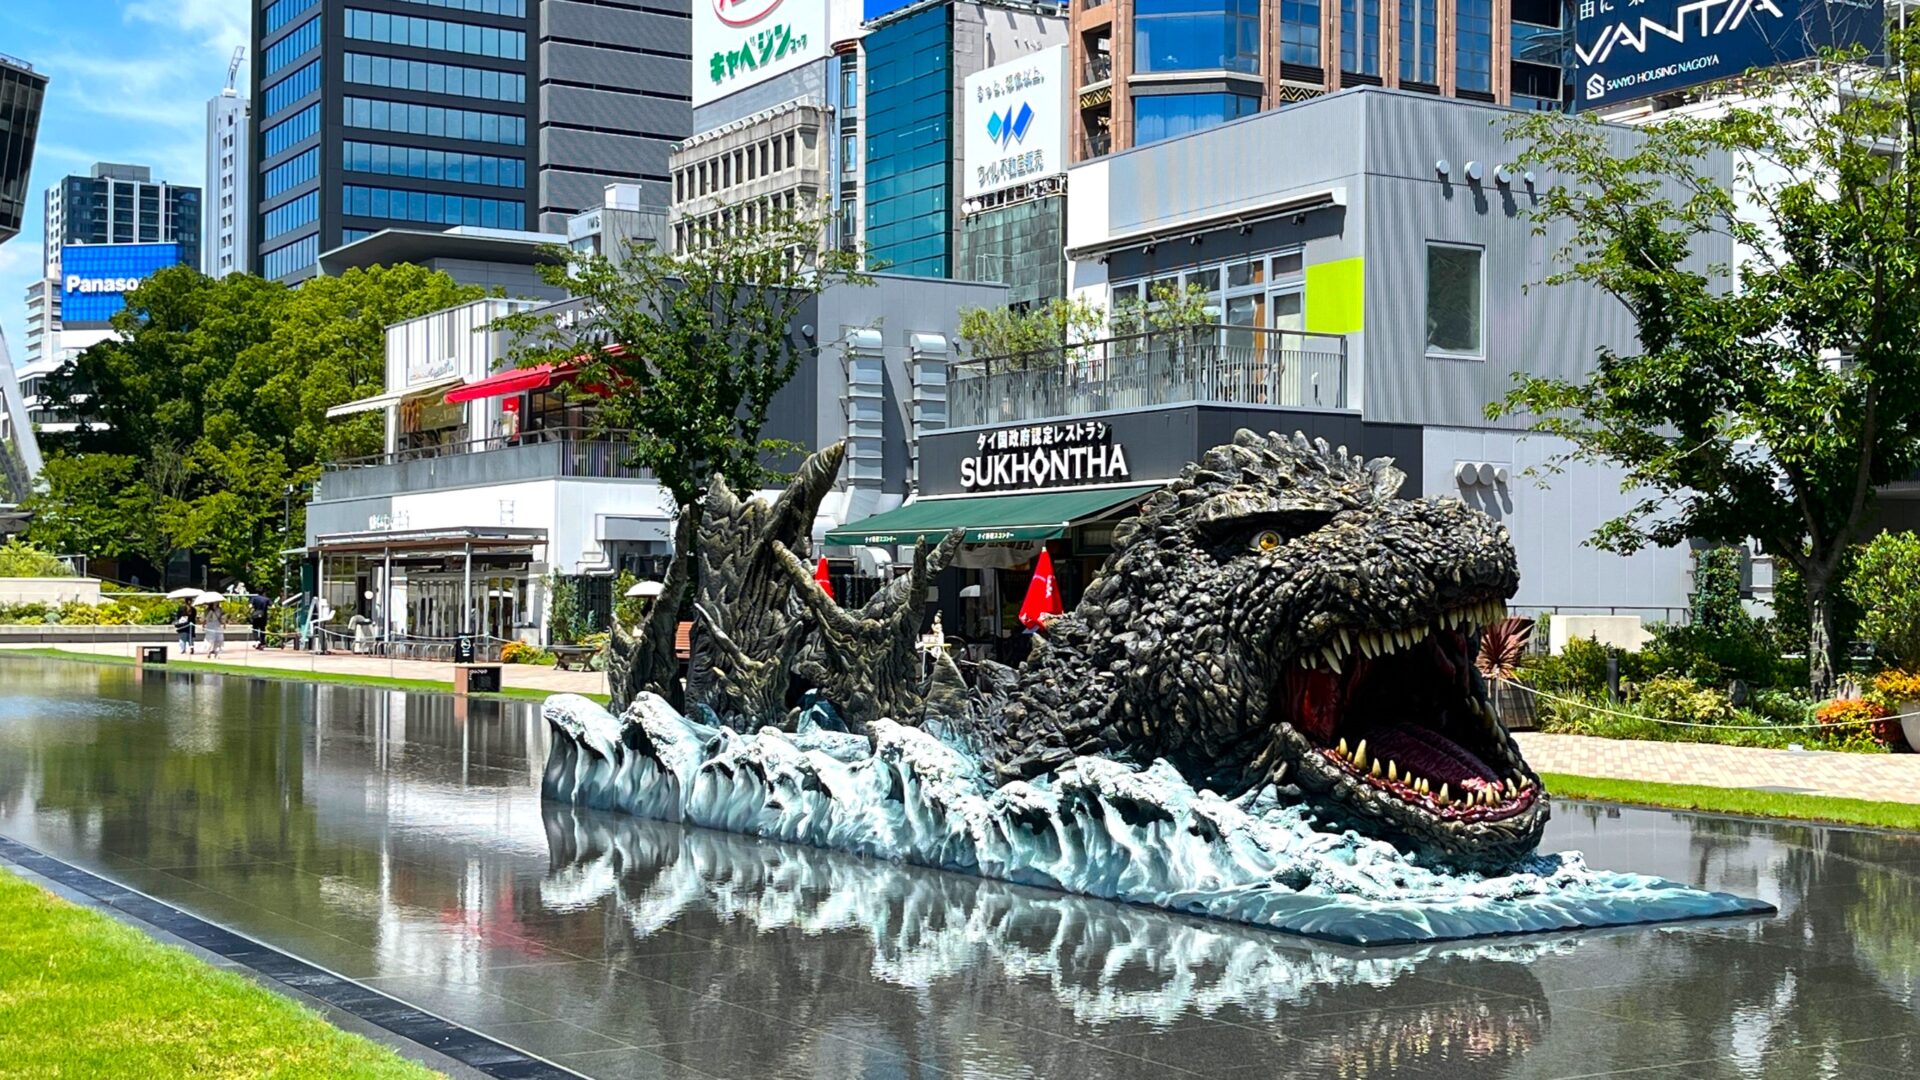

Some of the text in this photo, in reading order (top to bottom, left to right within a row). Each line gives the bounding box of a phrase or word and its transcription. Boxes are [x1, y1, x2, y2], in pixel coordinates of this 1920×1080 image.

[1575, 0, 1784, 69] VANTIA
[1606, 54, 1720, 91] SANYO HOUSING NAGOYA
[66, 275, 143, 294] Panaso
[976, 421, 1107, 451] タイ国政府認定レストラン
[959, 443, 1129, 488] SUKHONTHA
